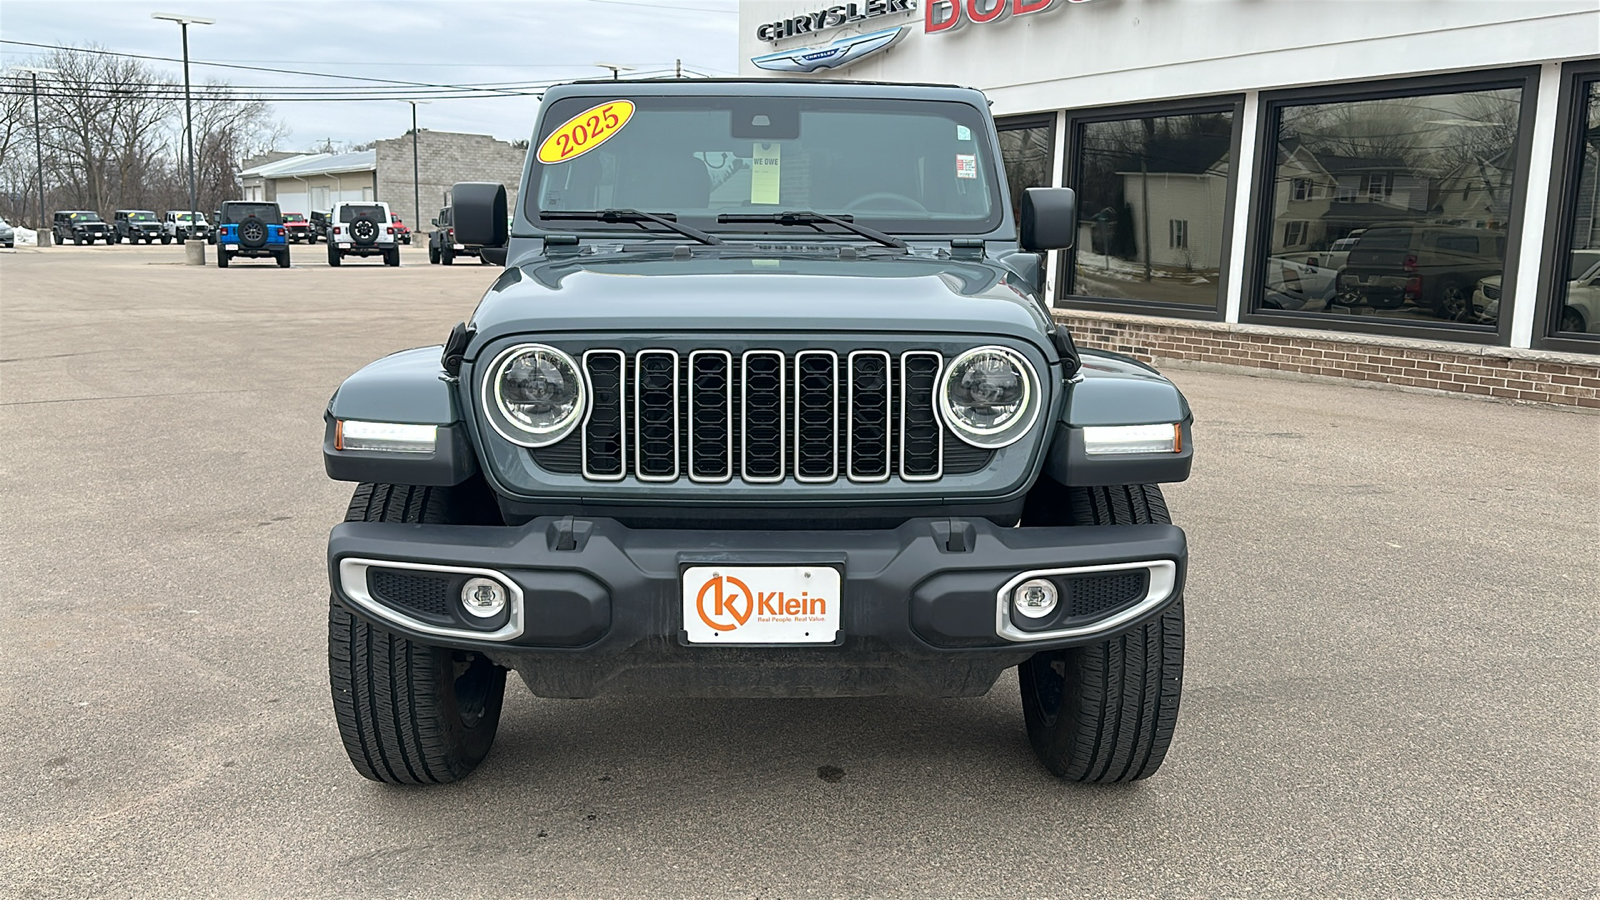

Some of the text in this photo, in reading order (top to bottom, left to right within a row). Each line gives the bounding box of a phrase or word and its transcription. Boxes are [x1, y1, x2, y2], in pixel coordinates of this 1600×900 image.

[757, 0, 909, 41] CHRYSLER
[805, 50, 835, 60] CHRYSLER
[556, 105, 619, 158] 2025
[753, 157, 779, 166] WE OWE
[758, 592, 826, 615] Klein
